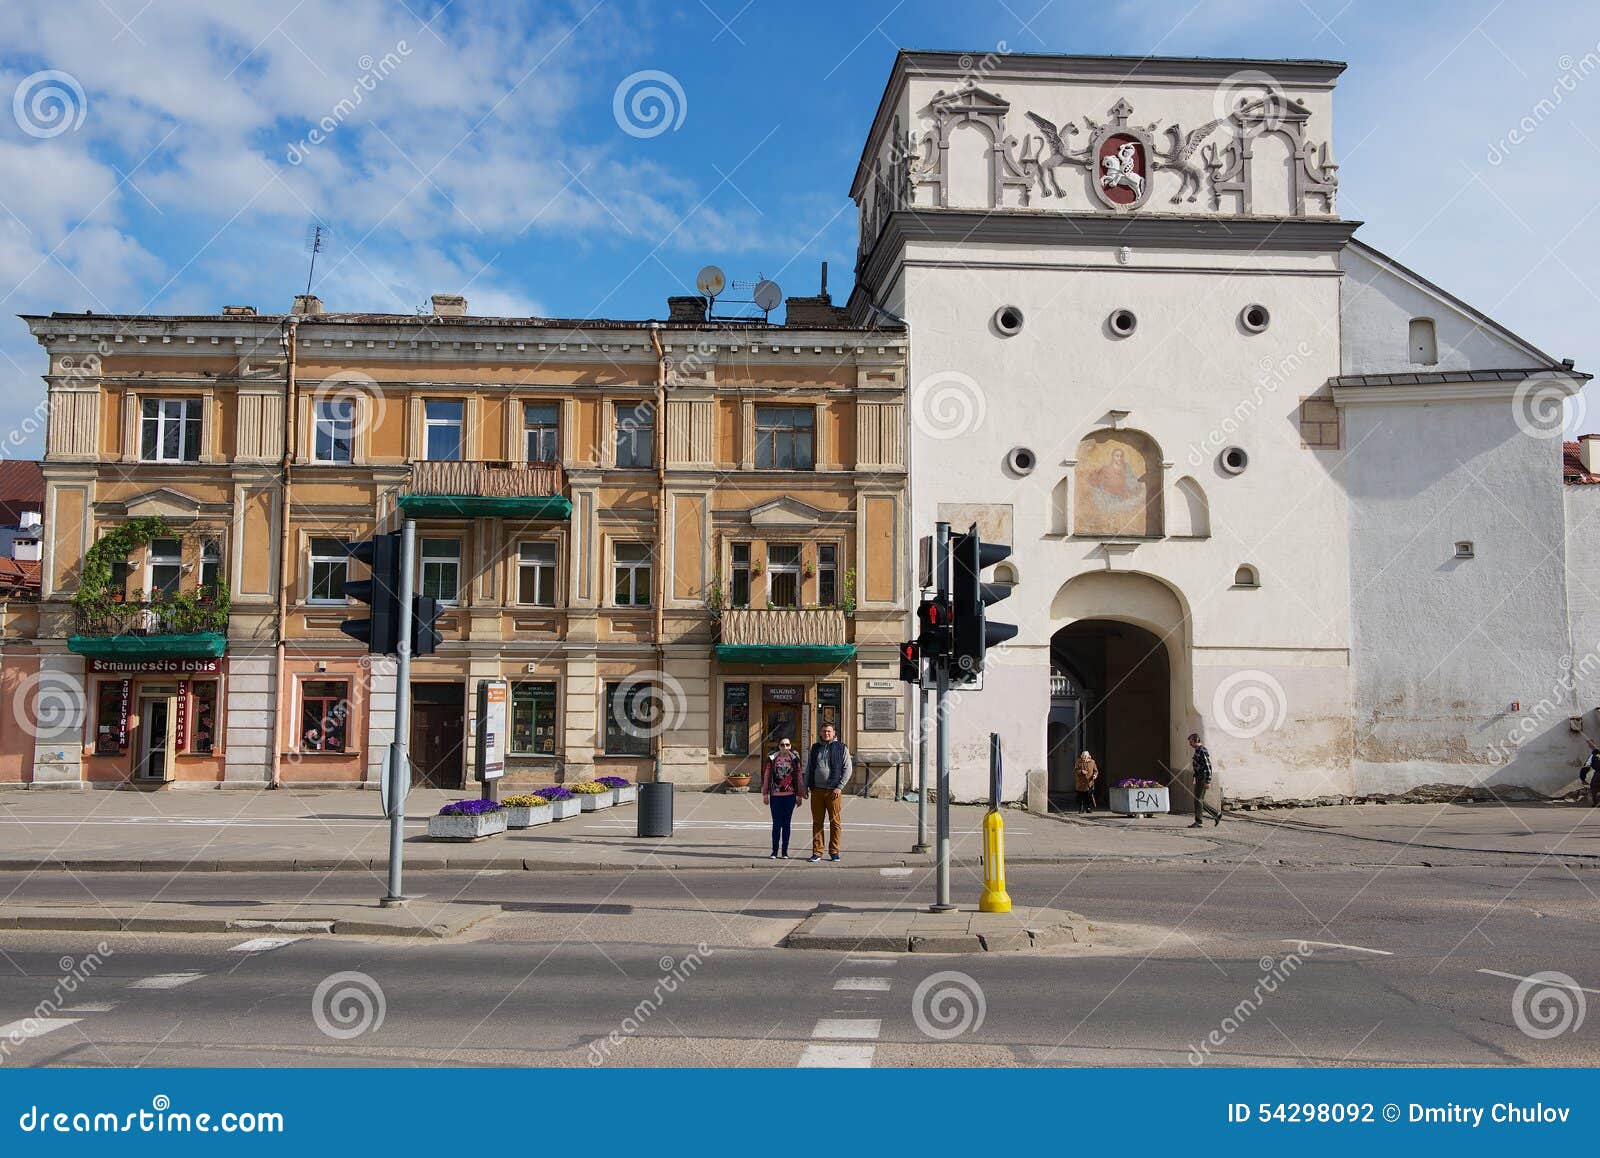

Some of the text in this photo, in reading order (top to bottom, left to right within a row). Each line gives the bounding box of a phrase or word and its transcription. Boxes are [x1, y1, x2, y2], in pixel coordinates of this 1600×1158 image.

[93, 659, 217, 672] Senamiesčio lobis
[119, 680, 129, 745] JUVELYRIKA
[177, 681, 186, 745] LOMBARDAS
